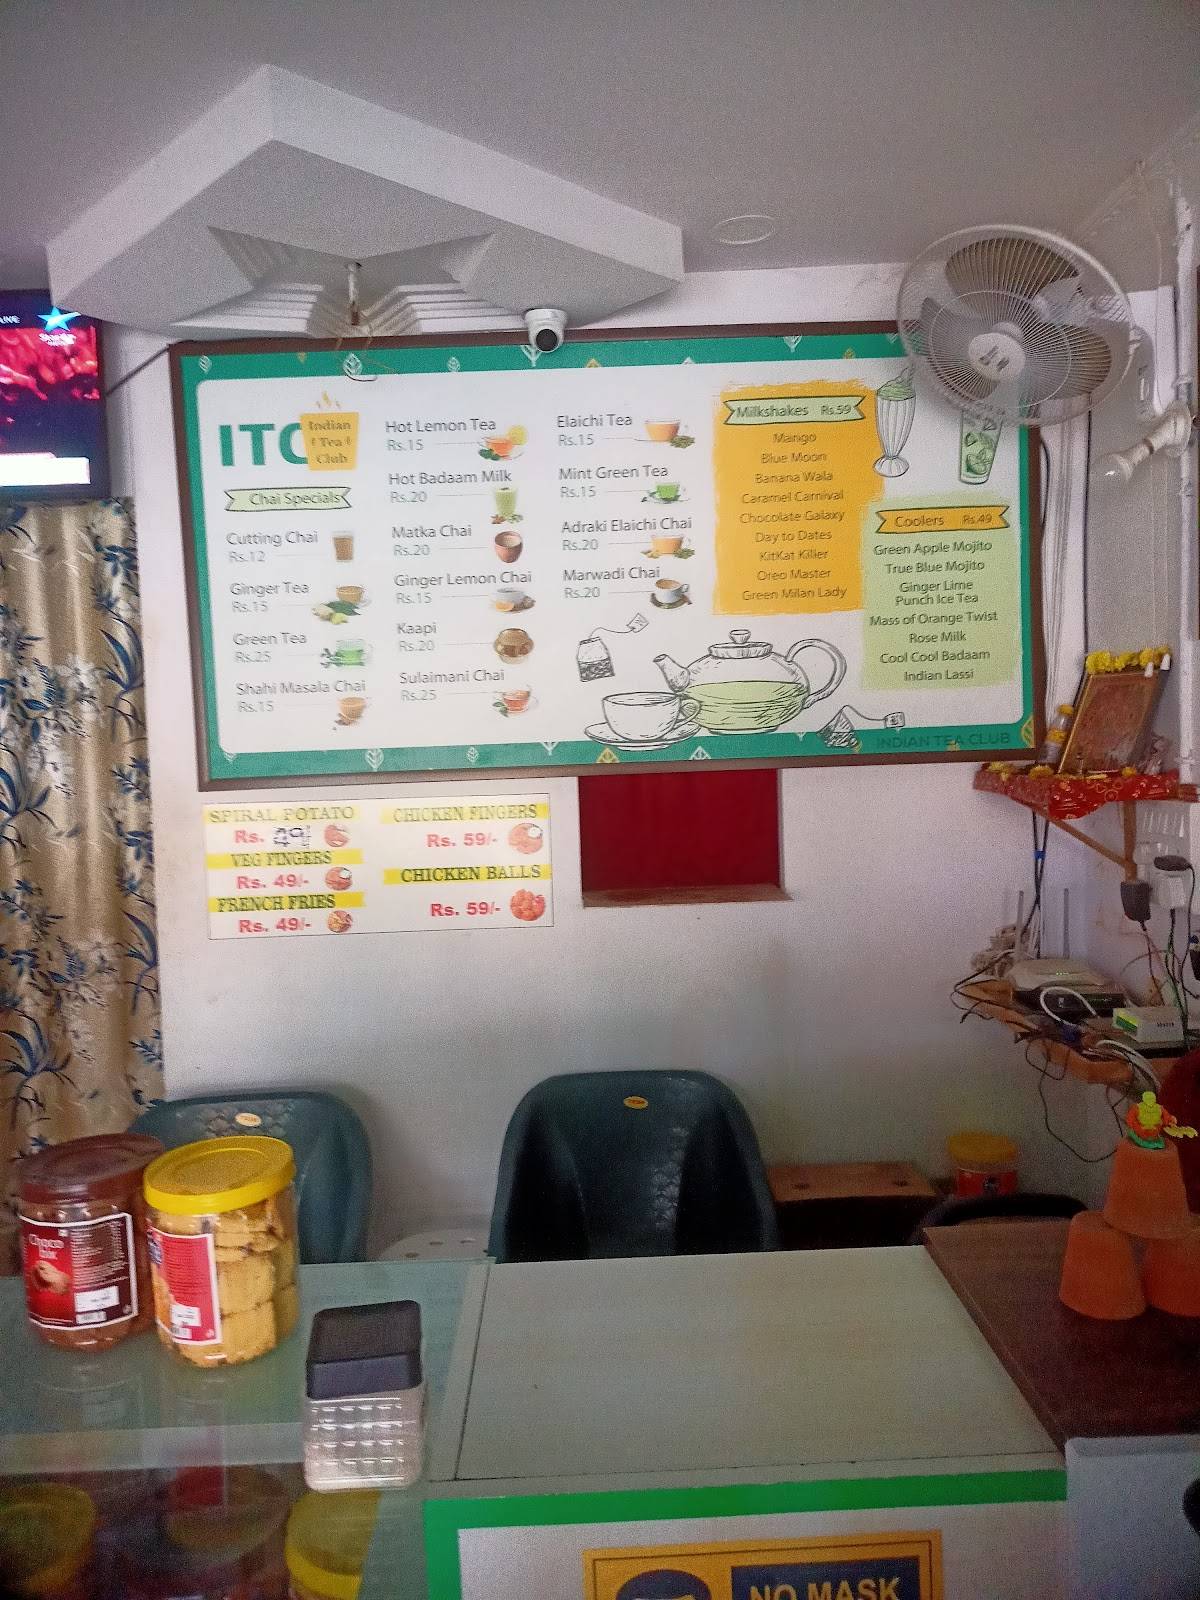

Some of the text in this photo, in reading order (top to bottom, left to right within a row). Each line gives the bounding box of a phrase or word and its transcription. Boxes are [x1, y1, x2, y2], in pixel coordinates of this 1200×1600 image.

[736, 404, 851, 418] Milkshakes Rs.59
[308, 421, 351, 431] Indian
[385, 418, 496, 432] Hot Lemon Tea
[557, 414, 633, 428] Elaichi Tea
[218, 423, 308, 466] ITC
[321, 438, 342, 446] Tea
[387, 439, 424, 451] Rs.15
[558, 434, 594, 446] Rs.15
[773, 432, 817, 445] Mango
[316, 454, 349, 464] Club
[761, 452, 827, 464] Blue Moon
[389, 470, 512, 485] Hot Badaam Milk
[559, 465, 669, 480] Mint Green Tea
[755, 471, 833, 484] Banana Wala
[390, 491, 427, 503] Rs.20
[560, 486, 597, 498] Rs.15
[742, 490, 844, 505] Caramel Carnival
[249, 492, 340, 507] Chai Specials
[740, 511, 845, 524] Chocolate Galaxy
[894, 514, 993, 528] Coolers Rs.49
[392, 525, 472, 538] Matka Chai
[562, 517, 692, 533] Adraki Elaichi Chai
[226, 530, 318, 546] Cutting Chai
[755, 530, 832, 544] Day to Dates
[393, 545, 430, 556] Rs.20
[563, 539, 599, 551] Rs.20
[874, 540, 993, 555] Green Apple Mojito
[229, 551, 265, 562] Rs.12
[760, 549, 828, 561] KitKat Killer
[563, 566, 660, 581] Marwadi Chai
[885, 561, 985, 574] True Blue Mojito
[394, 571, 532, 588] Ginger Lemon Chai
[757, 569, 831, 581] Oreo Master
[230, 582, 309, 598] Ginger Tea
[564, 587, 601, 598] Rs.20
[742, 586, 847, 601] Green Milan Lady
[900, 580, 973, 594] Ginger Lime
[396, 593, 432, 604] Rs.15
[895, 593, 978, 606] Punch Ice Tea
[232, 601, 268, 612] Rs.15
[870, 611, 998, 626] Mass of Orange Twist
[397, 622, 437, 636] Kaapi
[233, 632, 307, 646] Green Tea
[909, 631, 966, 643] Rose Milk
[399, 640, 434, 651] Rs.20
[235, 651, 271, 663] Rs.25
[880, 650, 990, 664] Cool Cool Badaam
[400, 669, 505, 684] Sulaimani Chai
[904, 669, 974, 681] Indian Lassi
[236, 680, 366, 695] Shahi Masala Chai
[401, 690, 437, 701] Rs.25
[238, 701, 274, 713] Rs.15
[876, 732, 1009, 748] INDIAN TEA CLUB
[209, 807, 354, 823] SPIRAL POTATO
[393, 804, 537, 822] CHICKEN FINGERS
[234, 830, 264, 844] Rs.
[427, 833, 497, 847] Rs. 59/-
[231, 851, 332, 867] VEG FINGERS
[401, 865, 541, 882] CHICKEN BALLS
[237, 874, 309, 889] Rs. 49/-
[217, 894, 336, 912] FRENCH FRIES
[431, 902, 500, 916] Rs. 59/-
[239, 917, 311, 933] Rs. 49/-
